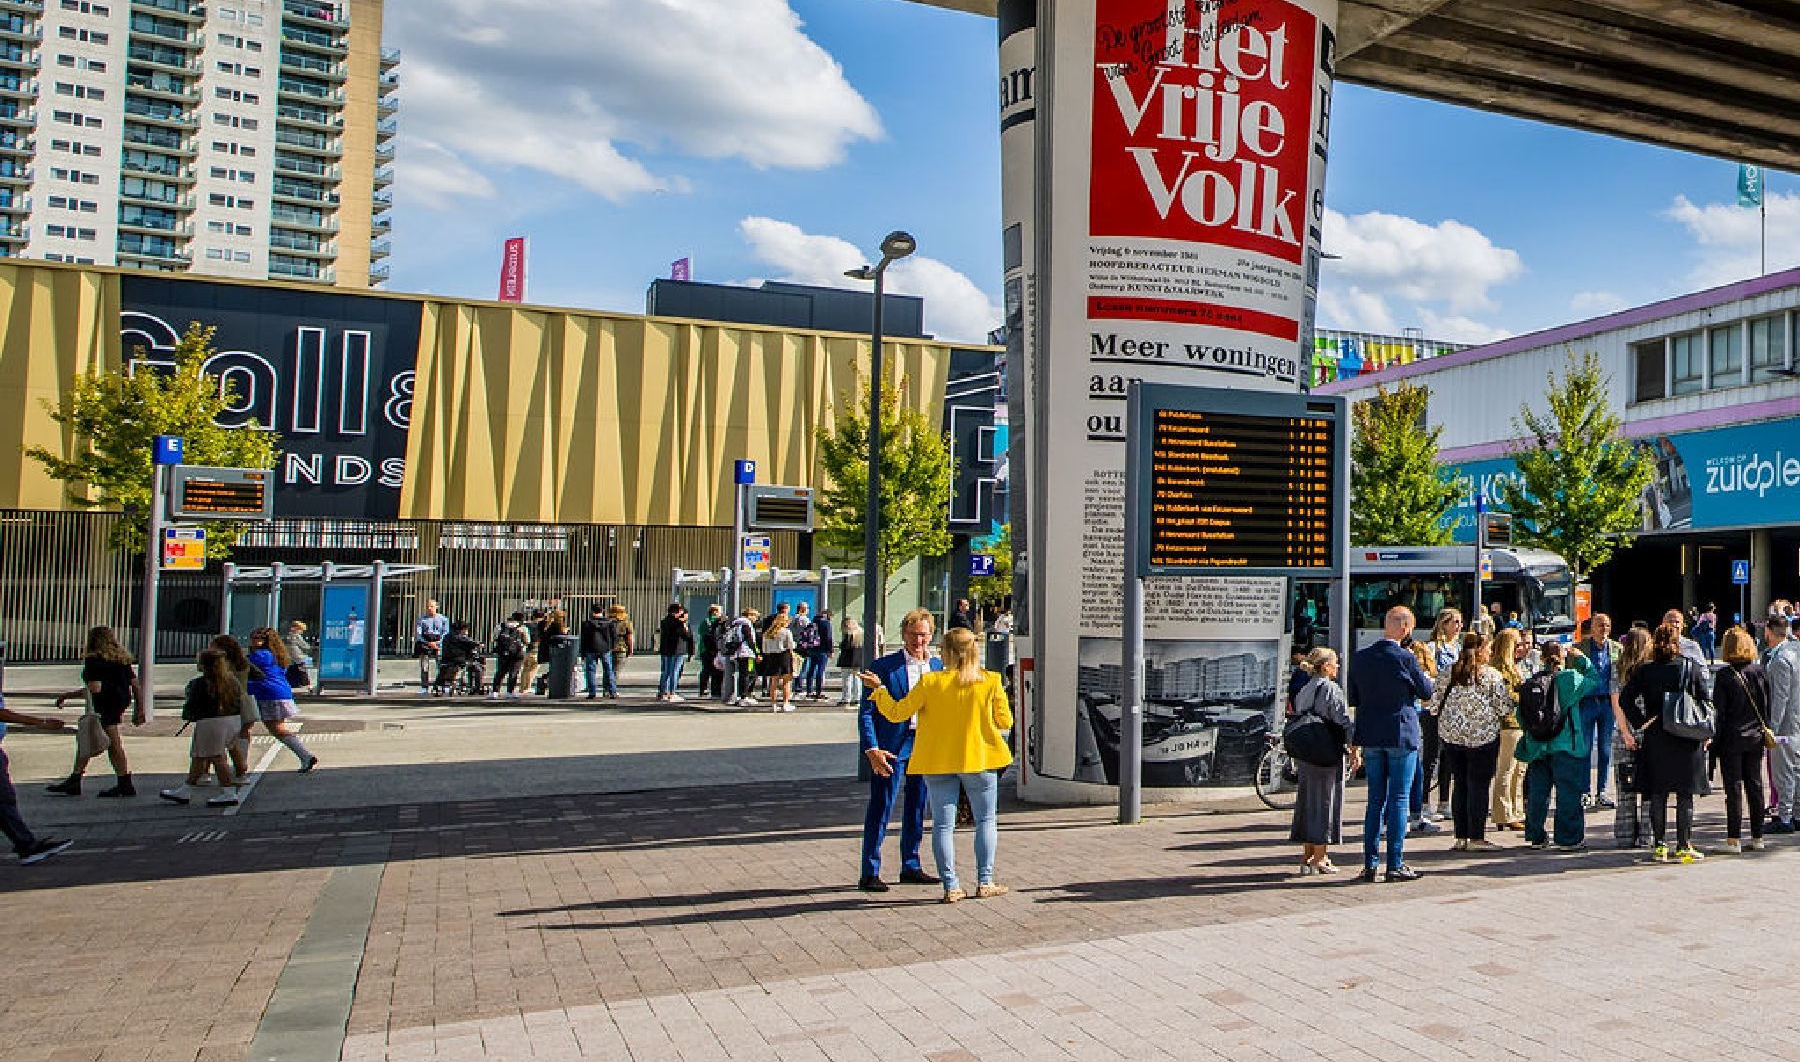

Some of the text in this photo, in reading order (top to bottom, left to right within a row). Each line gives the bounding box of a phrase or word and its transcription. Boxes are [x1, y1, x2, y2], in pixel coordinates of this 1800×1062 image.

[1096, 62, 1285, 162] Vrije
[1124, 147, 1301, 246] Volk
[1132, 249, 1178, 258] november
[1089, 260, 1195, 274] HOOFDREDACTEUR
[1090, 333, 1296, 376] Meer woningen
[1087, 416, 1123, 433] ou
[167, 439, 179, 452] E
[1455, 470, 1527, 507] ELKOM
[983, 556, 992, 569] P
